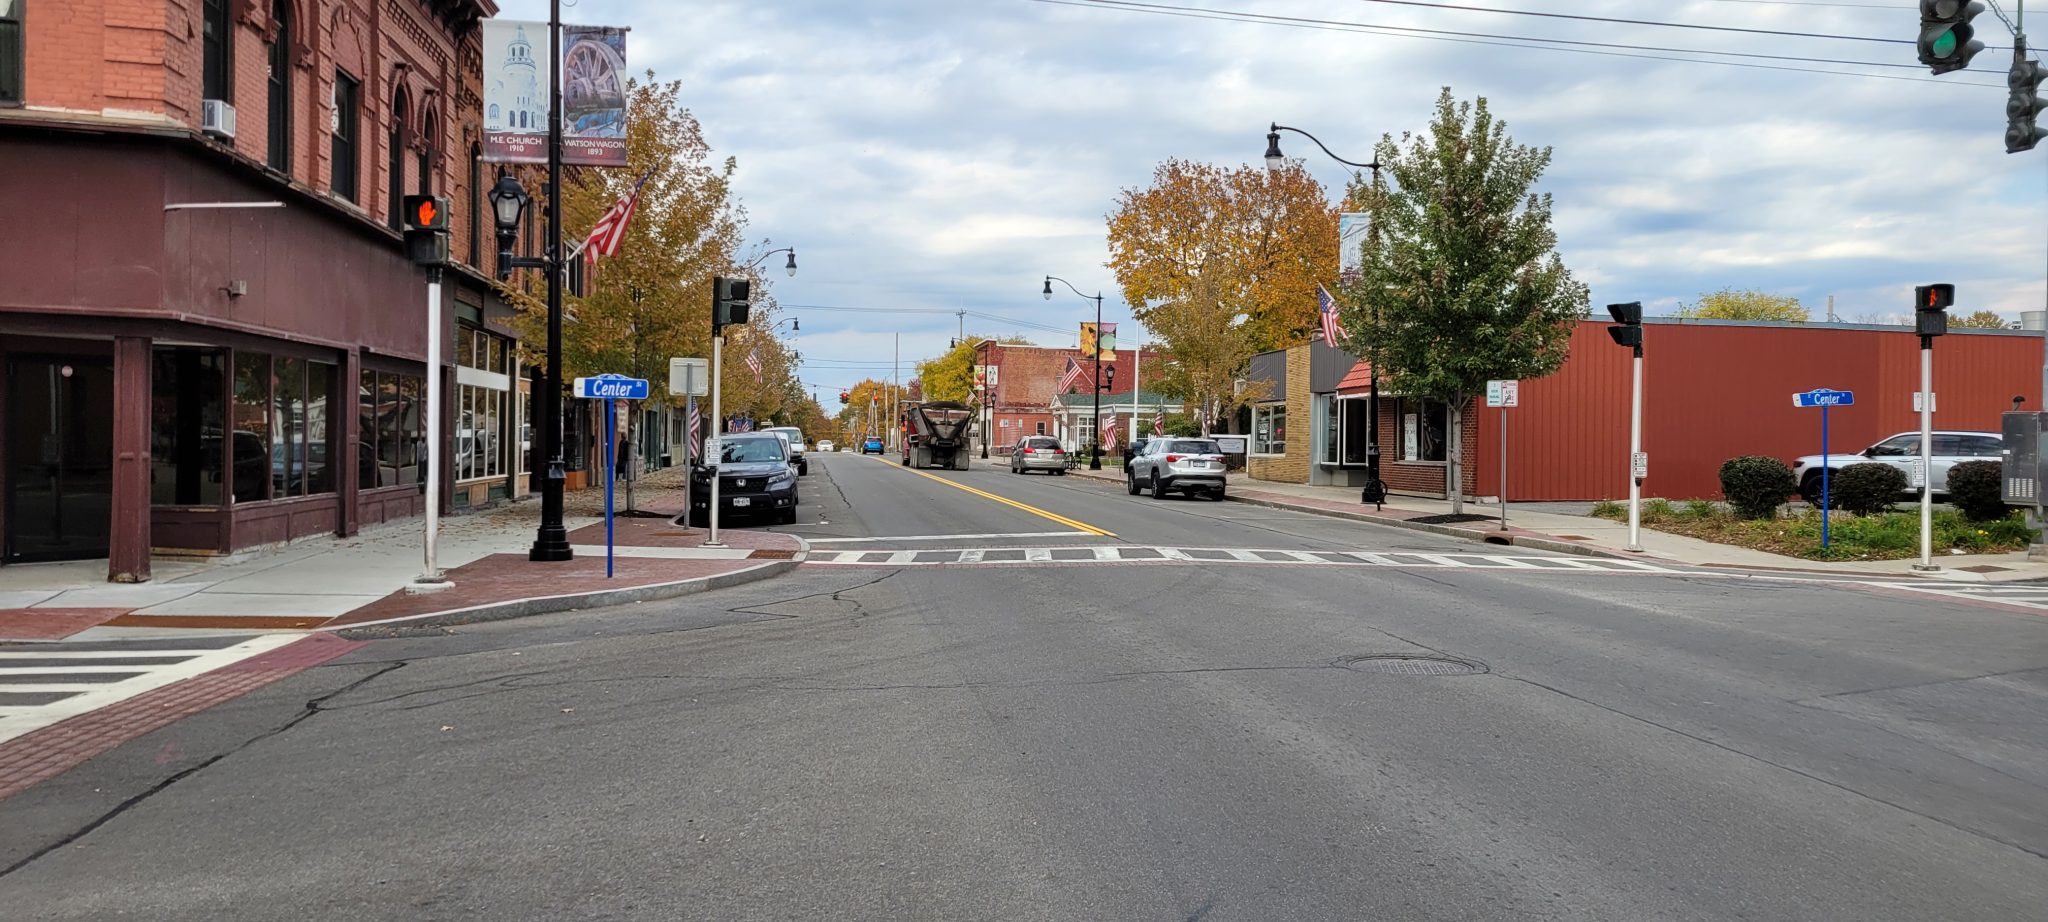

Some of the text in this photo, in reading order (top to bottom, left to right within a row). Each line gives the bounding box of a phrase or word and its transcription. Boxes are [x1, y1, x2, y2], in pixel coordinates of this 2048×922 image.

[490, 135, 543, 145] M.E. CHURCH
[564, 139, 625, 149] WATSON WAGON
[509, 144, 525, 152] 1910
[587, 147, 603, 155] 1893
[593, 380, 633, 397] Center
[1814, 393, 1840, 405] Center
